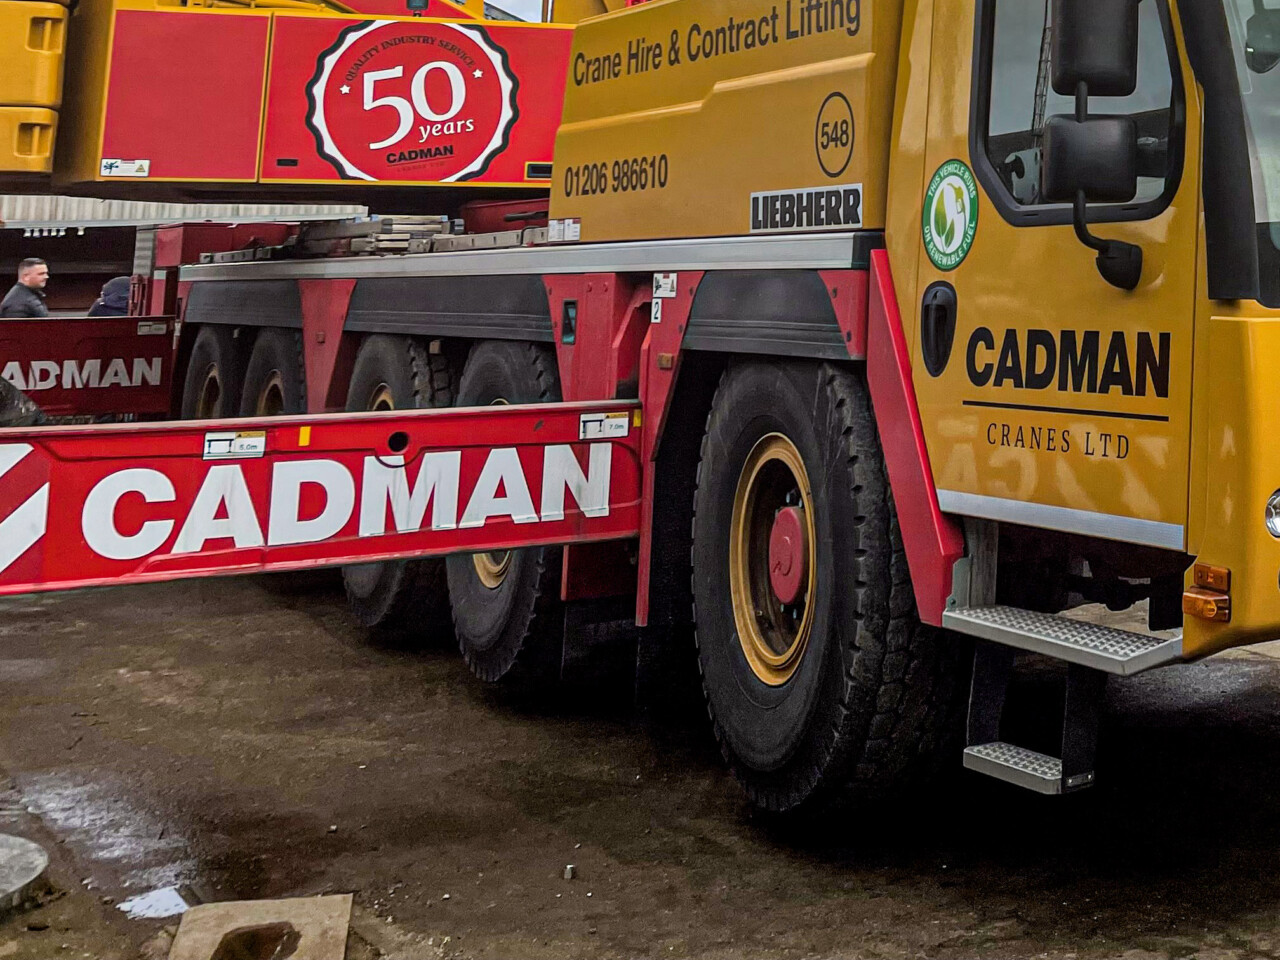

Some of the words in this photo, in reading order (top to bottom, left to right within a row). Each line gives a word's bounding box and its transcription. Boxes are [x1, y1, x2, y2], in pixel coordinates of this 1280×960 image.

[345, 45, 380, 82] QUALITY
[381, 35, 437, 50] INDUSTRY
[437, 39, 476, 68] SERVICE
[573, 51, 621, 86] Crane
[626, 35, 662, 76] Hire
[668, 29, 680, 66] &
[687, 5, 779, 62] Contract
[363, 60, 466, 150] 50
[419, 119, 474, 143] years
[820, 119, 850, 151] 548
[386, 145, 454, 164] CADMAN
[564, 161, 607, 198] 01206
[612, 154, 668, 193] 986610
[928, 176, 941, 197] THIS
[940, 164, 964, 177] VEHICLE
[963, 172, 977, 198] RUNS
[751, 187, 861, 230] LIEBHERR
[924, 225, 931, 241] ON
[929, 243, 964, 266] RENEWABLE
[963, 221, 975, 251] FUEL
[653, 301, 660, 320] 2
[966, 326, 1171, 399] CADMAN
[987, 422, 1071, 453] CRANES
[1084, 431, 1130, 460] LTD
[81, 442, 613, 560] CADMAN
